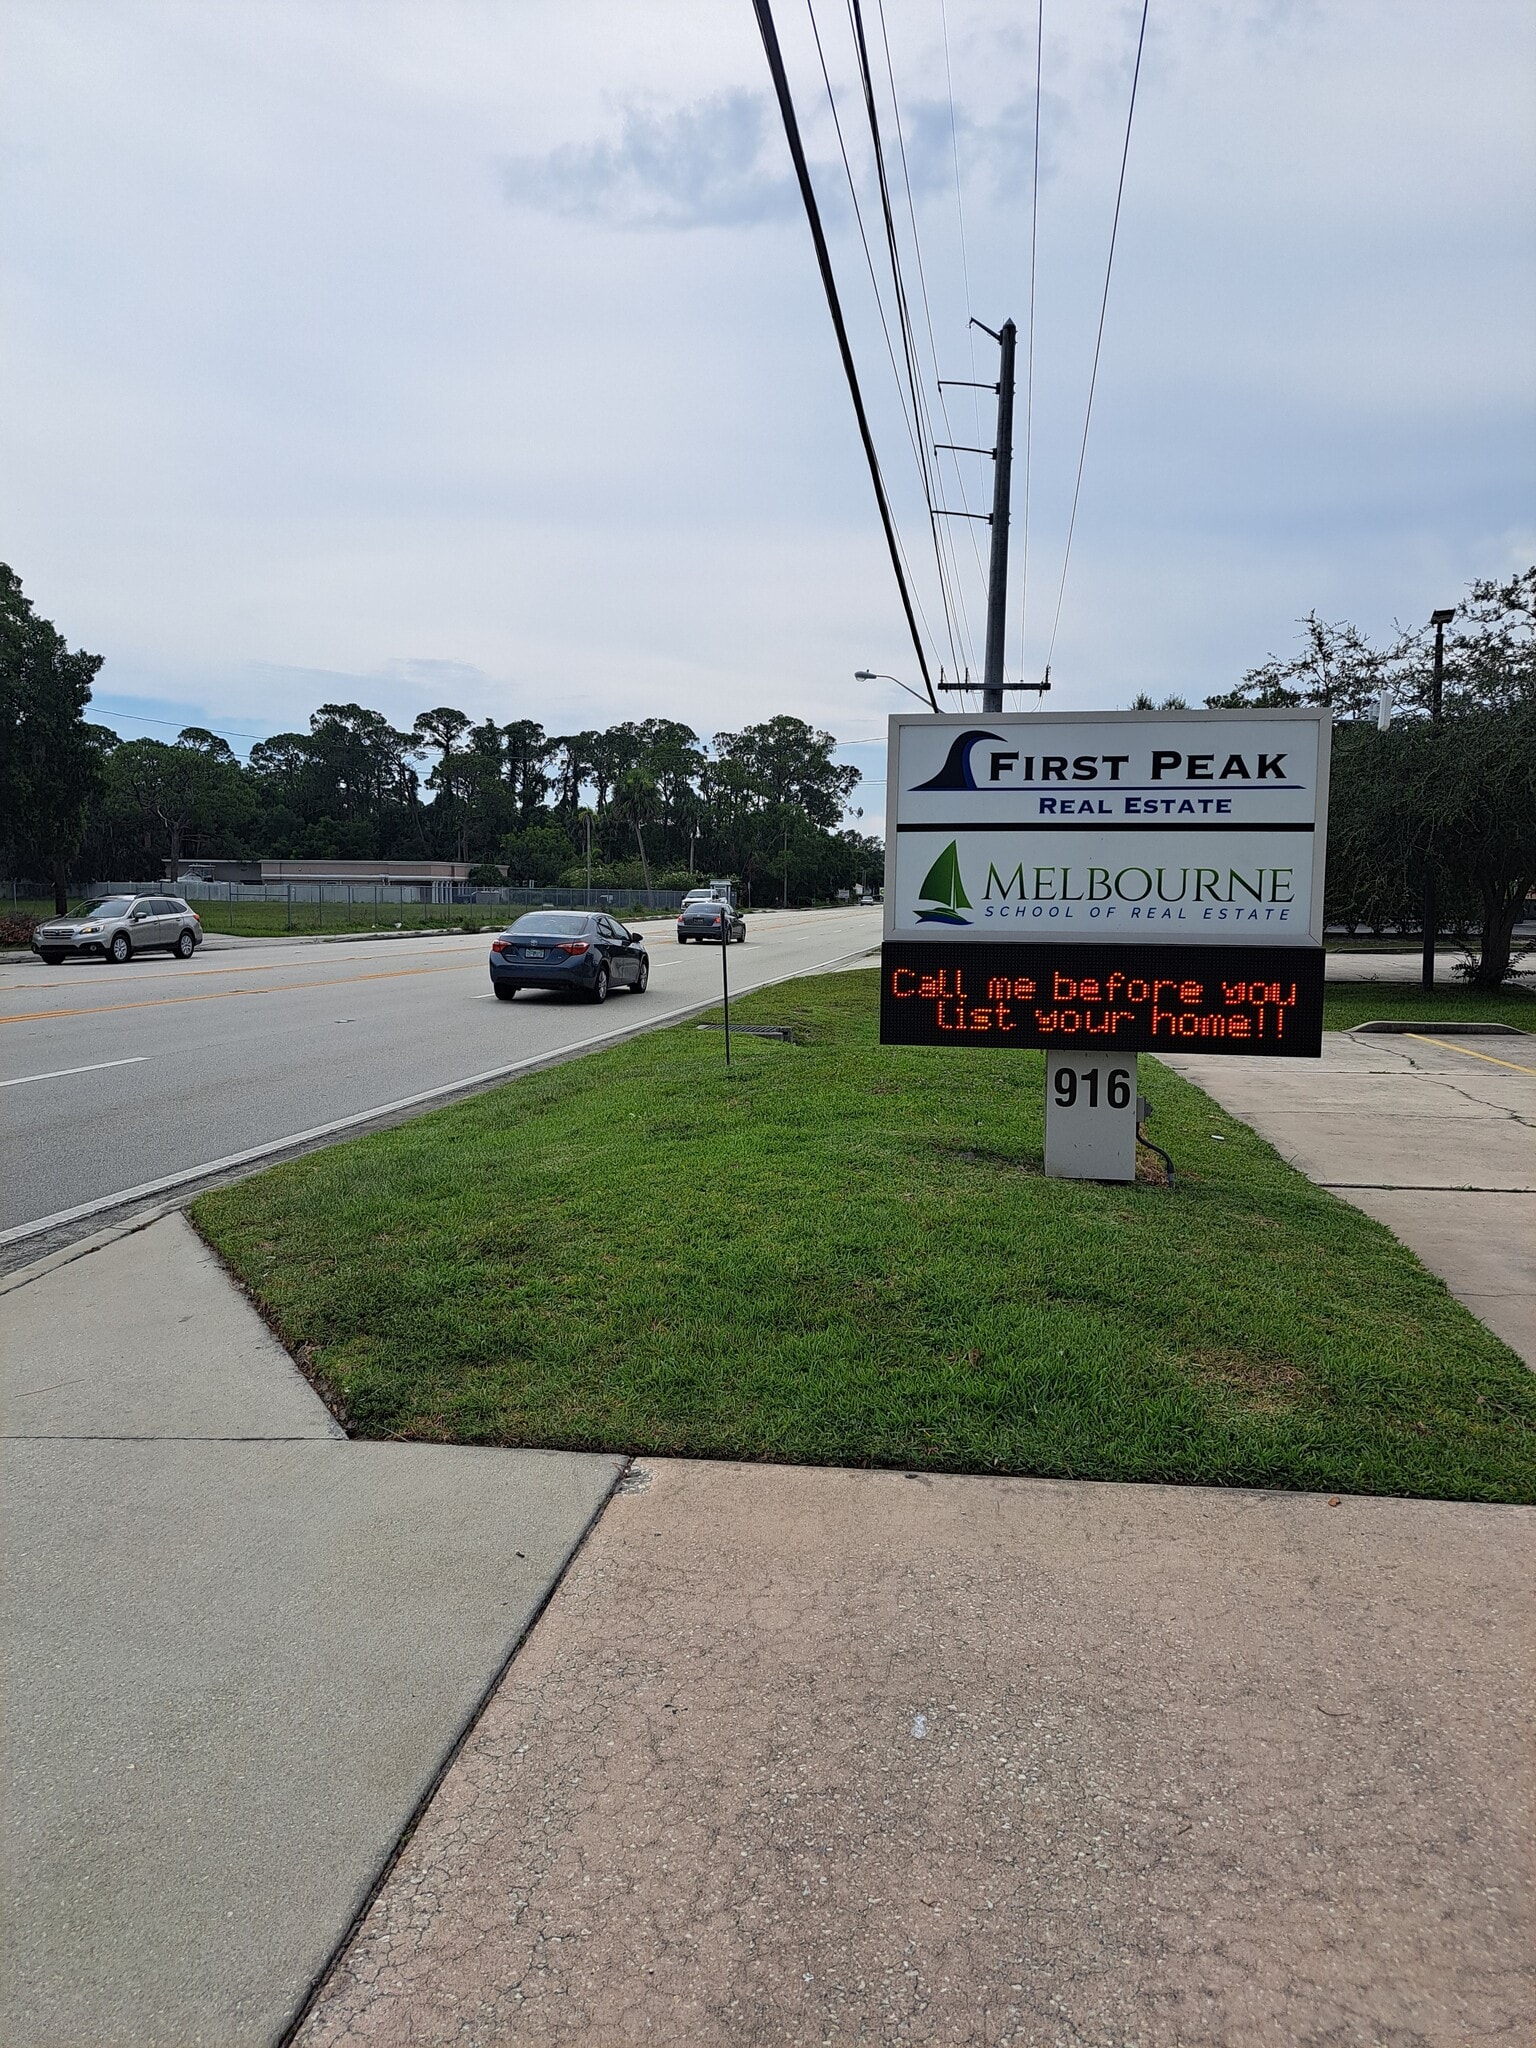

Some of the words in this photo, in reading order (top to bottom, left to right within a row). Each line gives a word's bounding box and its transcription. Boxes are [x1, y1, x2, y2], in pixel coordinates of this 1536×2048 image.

[981, 861, 1296, 903] MELBOURNE
[984, 905, 1074, 919] SCHOOL
[1089, 906, 1117, 919] OF
[1131, 907, 1187, 920] REAL
[1203, 907, 1291, 921] ESTATE
[891, 968, 968, 999] Call
[988, 975, 1037, 1000] me
[1053, 971, 1204, 1004] before
[1222, 980, 1297, 1006] you
[1034, 1009, 1136, 1033] your
[1151, 1004, 1285, 1039] home!!
[1053, 1067, 1132, 1110] 916
